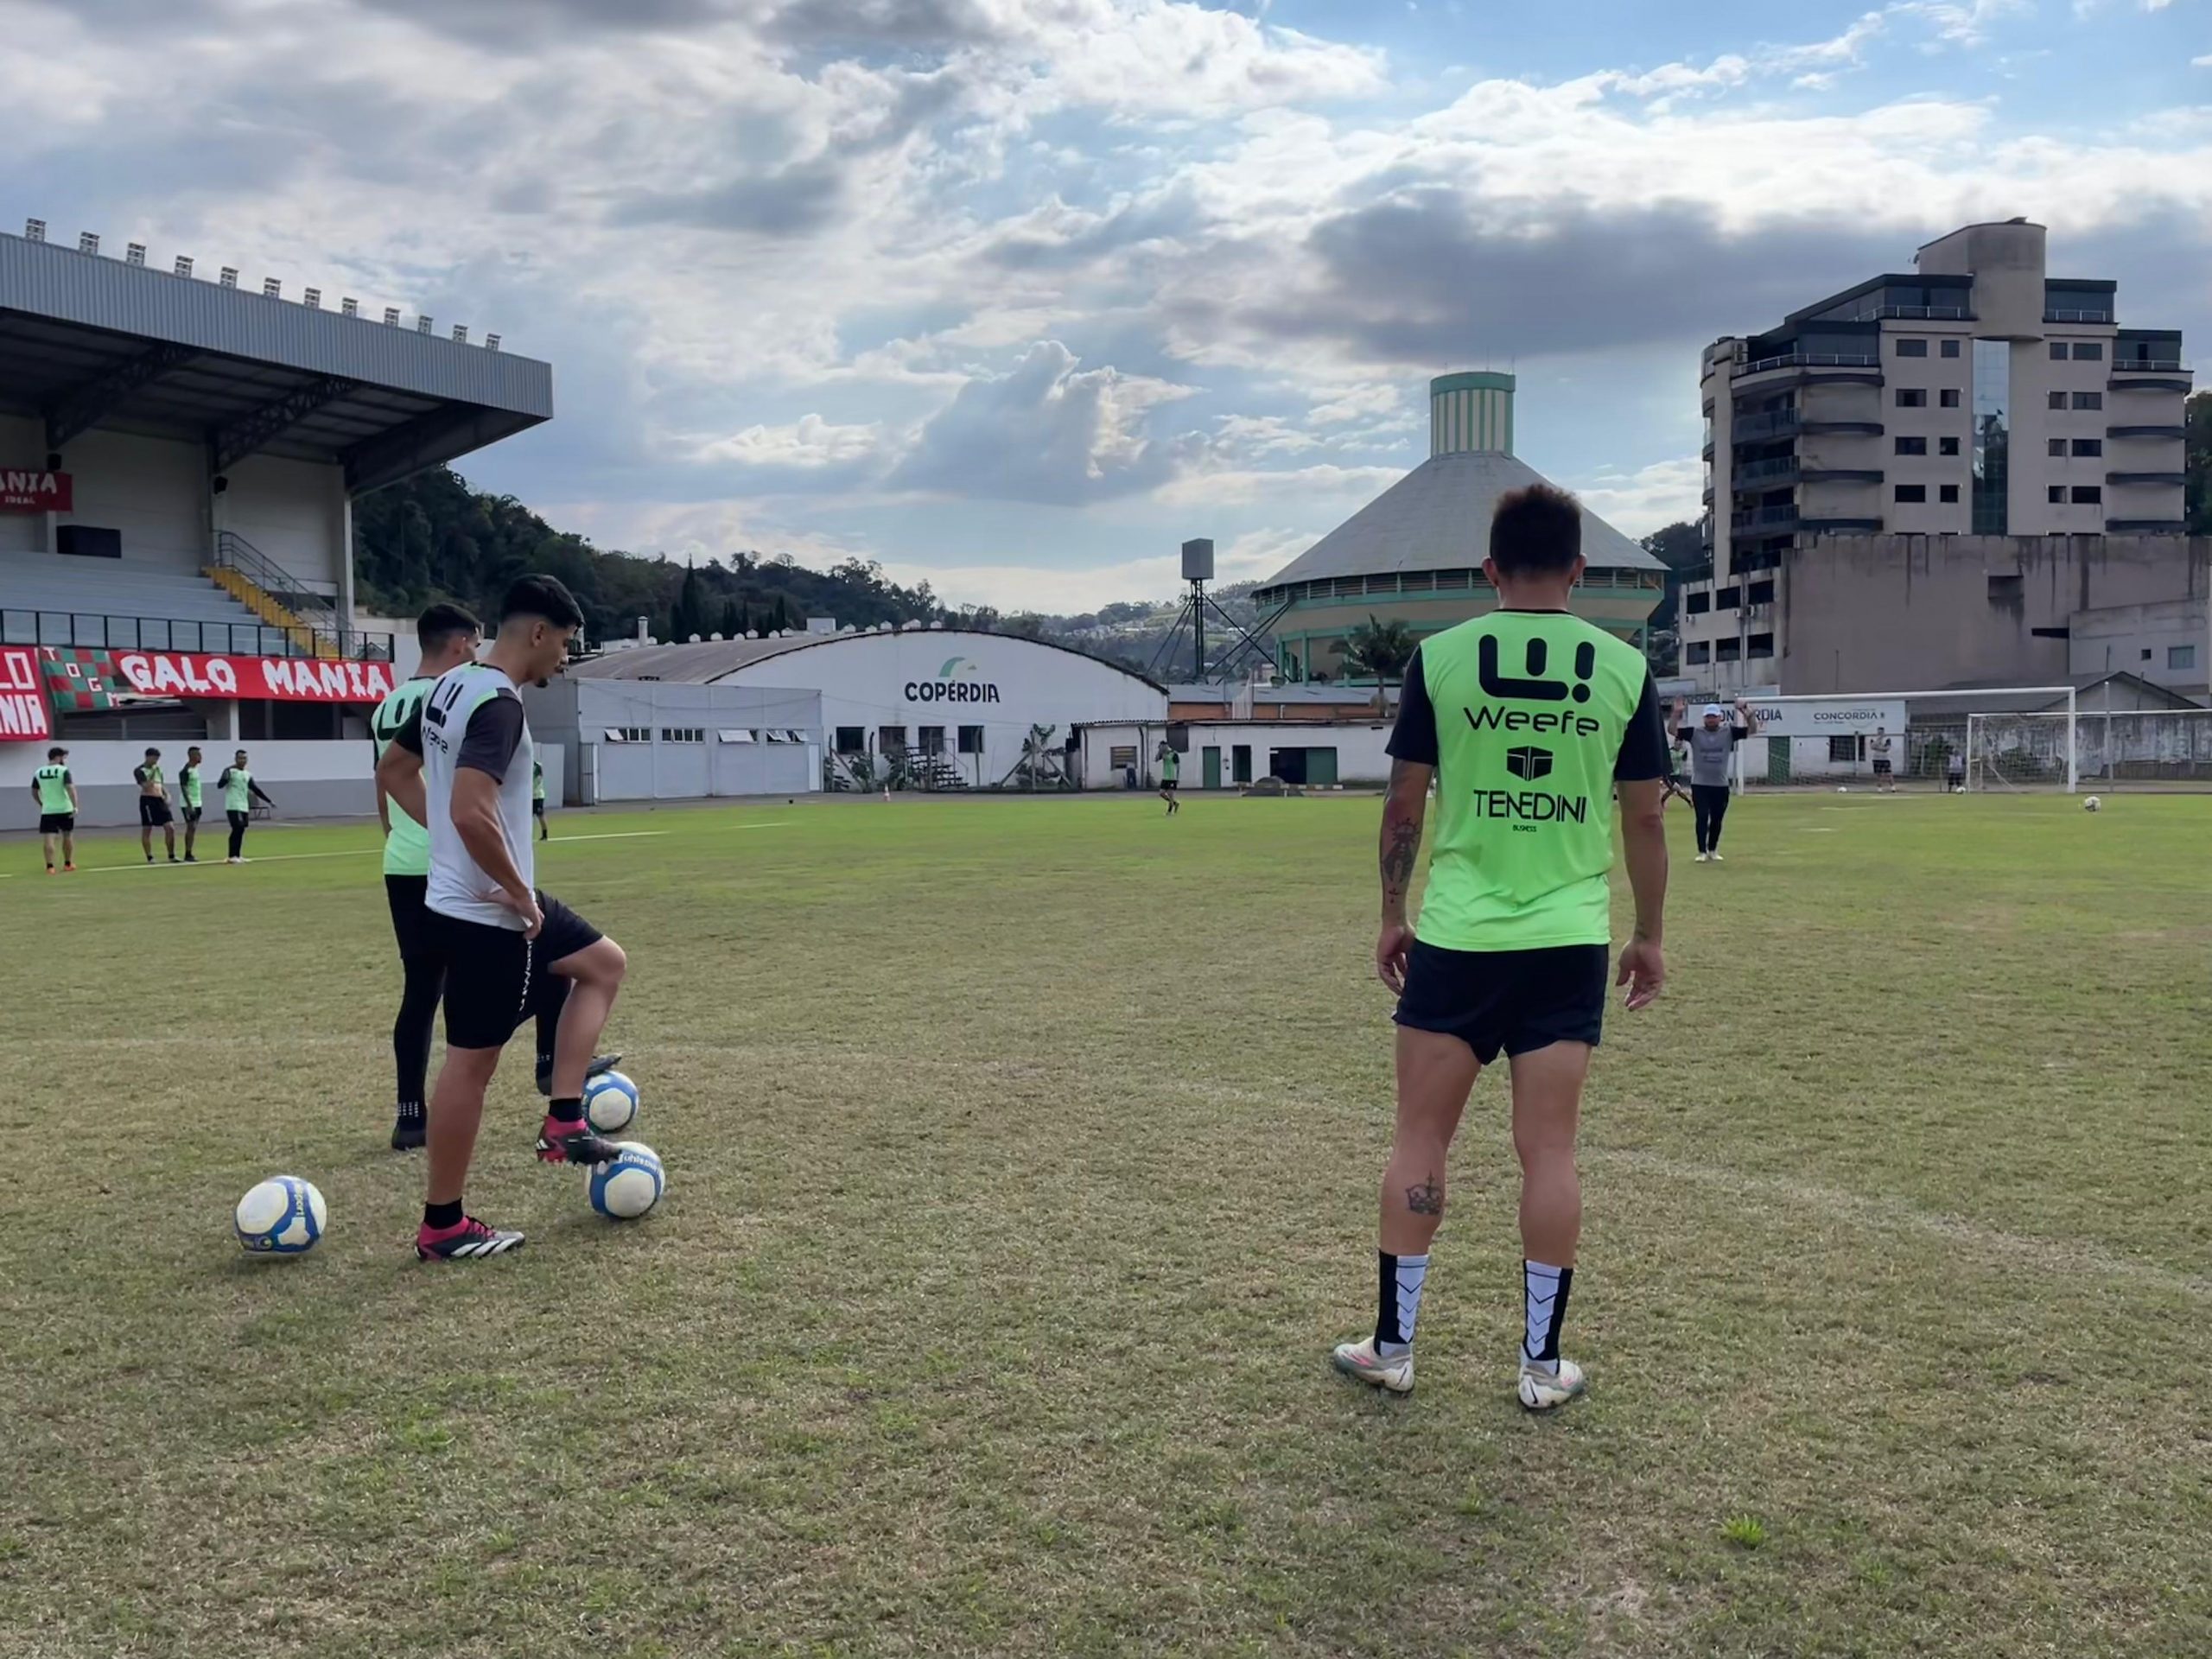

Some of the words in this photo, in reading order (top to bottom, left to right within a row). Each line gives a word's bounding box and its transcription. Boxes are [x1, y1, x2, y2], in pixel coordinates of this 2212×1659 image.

[120, 654, 237, 694] GALO
[262, 659, 390, 699] MANIA
[905, 679, 1000, 702] COPÉRDIA
[1463, 705, 1600, 736] Weefe
[1814, 711, 1878, 721] CONCORDIA
[1473, 789, 1587, 823] TENEDINI
